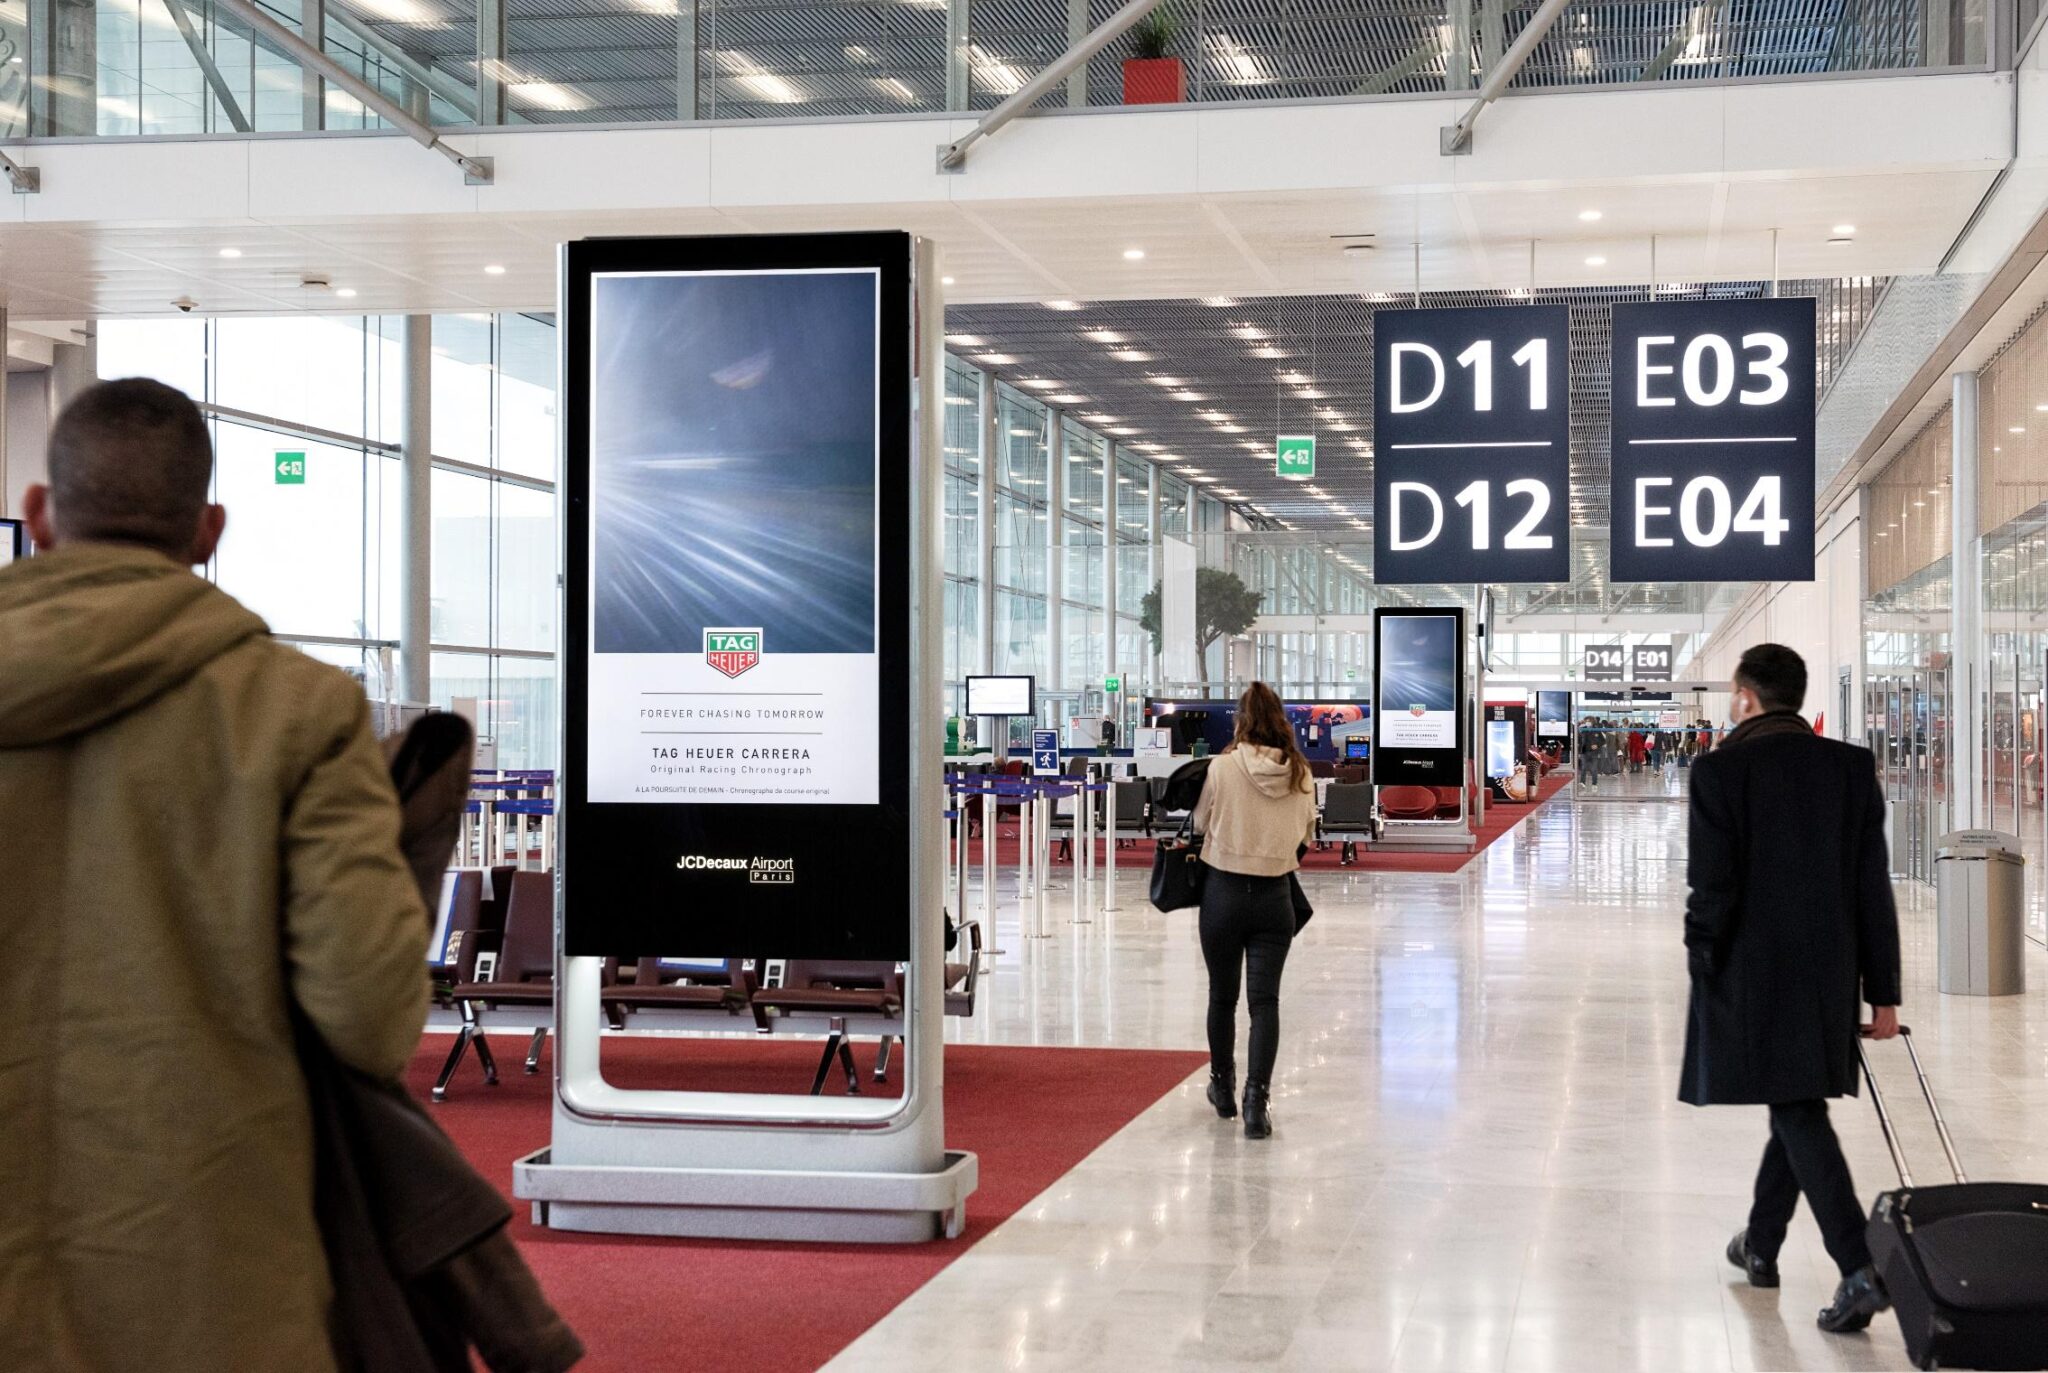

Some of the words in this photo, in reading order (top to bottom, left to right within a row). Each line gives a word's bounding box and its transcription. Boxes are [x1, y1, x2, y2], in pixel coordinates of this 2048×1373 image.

[1390, 338, 1548, 413] D11
[1636, 332, 1789, 407] E03
[1390, 478, 1553, 551] D12
[1634, 475, 1790, 548] E04
[711, 636, 753, 650] TAG
[710, 653, 755, 674] HEUER
[1586, 650, 1623, 668] D14
[1637, 650, 1668, 668] E01
[640, 709, 693, 718] FOREVER
[699, 709, 751, 719] CHASING
[757, 710, 824, 719] TOMORROW
[652, 748, 678, 759] TAG
[686, 748, 734, 759] HEUER
[741, 748, 810, 760] CARRERA
[650, 764, 695, 775] Original
[700, 765, 736, 776] Racing
[741, 765, 812, 777] Chronograph
[641, 785, 650, 793] LA
[651, 785, 688, 794] POURSUITE
[688, 785, 698, 794] DE
[699, 786, 725, 794] DEMAIN
[730, 786, 774, 796] Chronographe
[784, 787, 805, 795] course
[806, 787, 830, 797] original
[676, 856, 748, 870] JCDecaux
[750, 856, 794, 872] Airport
[753, 872, 791, 881] Paris
